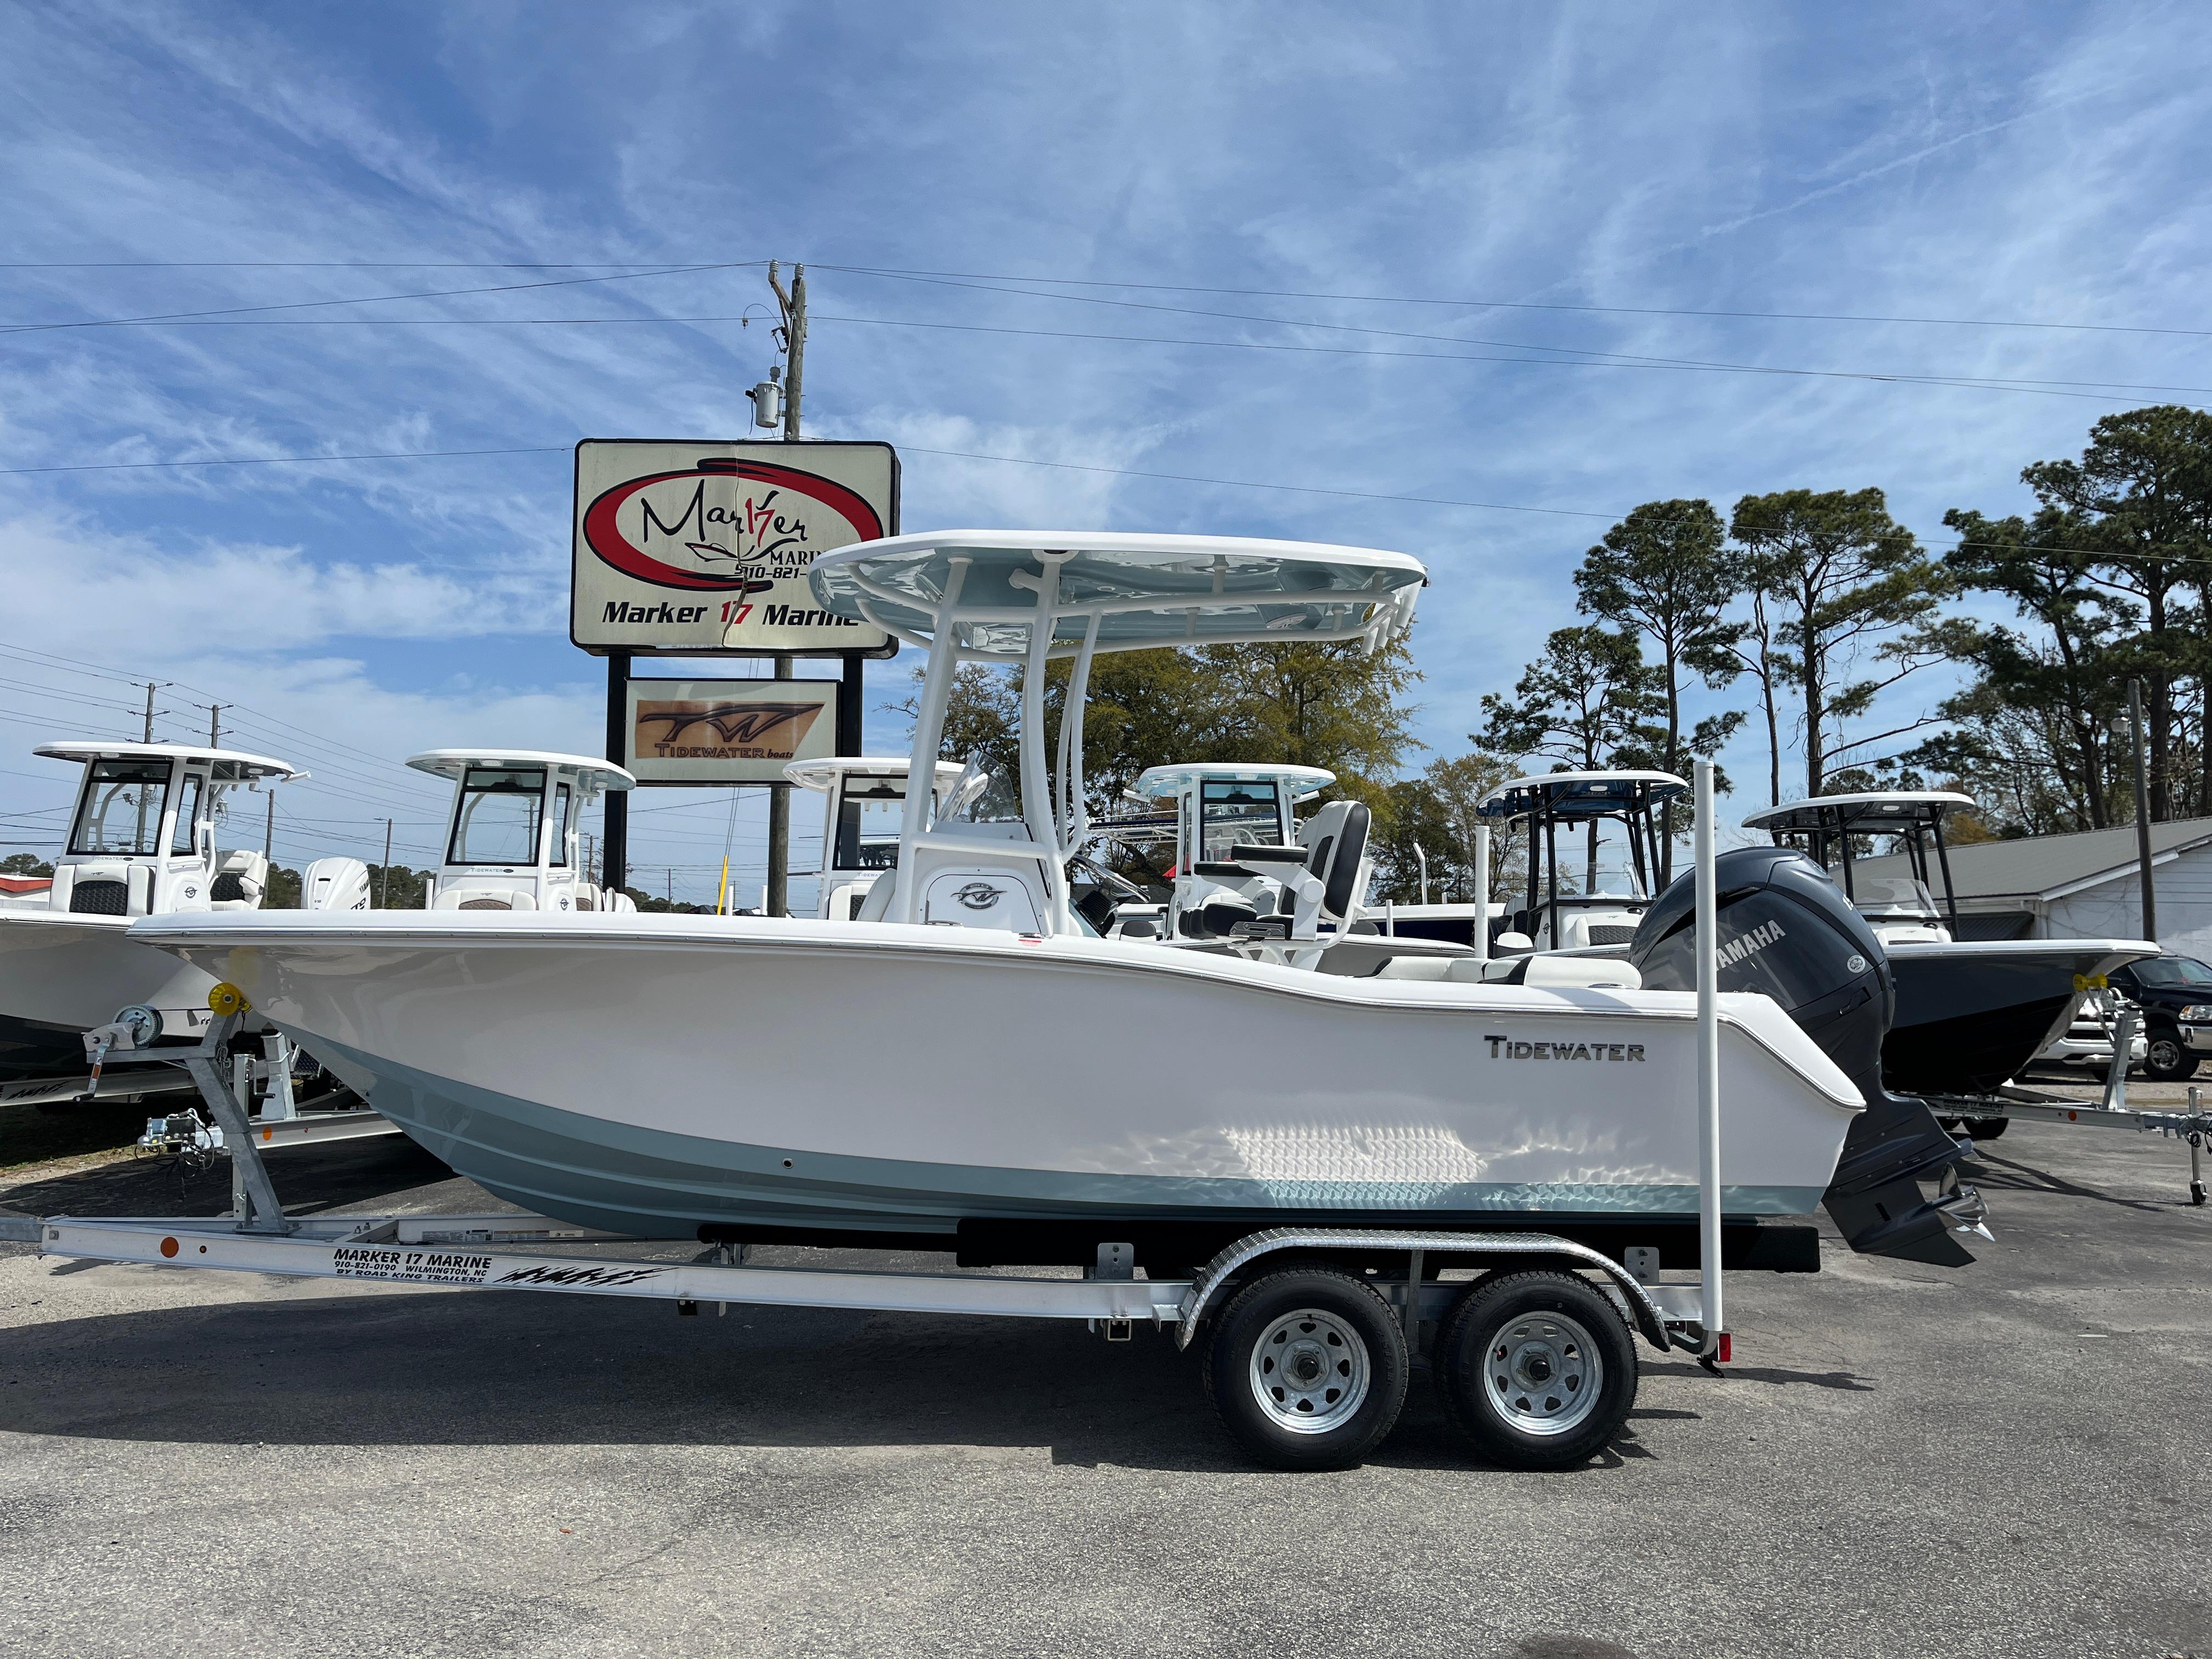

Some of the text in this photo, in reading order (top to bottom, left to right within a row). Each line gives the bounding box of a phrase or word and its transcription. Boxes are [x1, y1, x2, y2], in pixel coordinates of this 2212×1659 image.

[735, 564, 808, 579] 910-821-
[602, 601, 708, 623] Marker
[720, 601, 753, 624] 17
[654, 743, 794, 759] TIDEWATER boats
[1716, 919, 1786, 971] AMAHA
[1483, 1035, 1646, 1062] TIDEWATER
[334, 1248, 492, 1269] MARKER 17 MARINE
[335, 1261, 396, 1271] 910-821-0190
[406, 1265, 470, 1277] WILMINGTON,
[427, 1274, 484, 1283] TRAILERS
